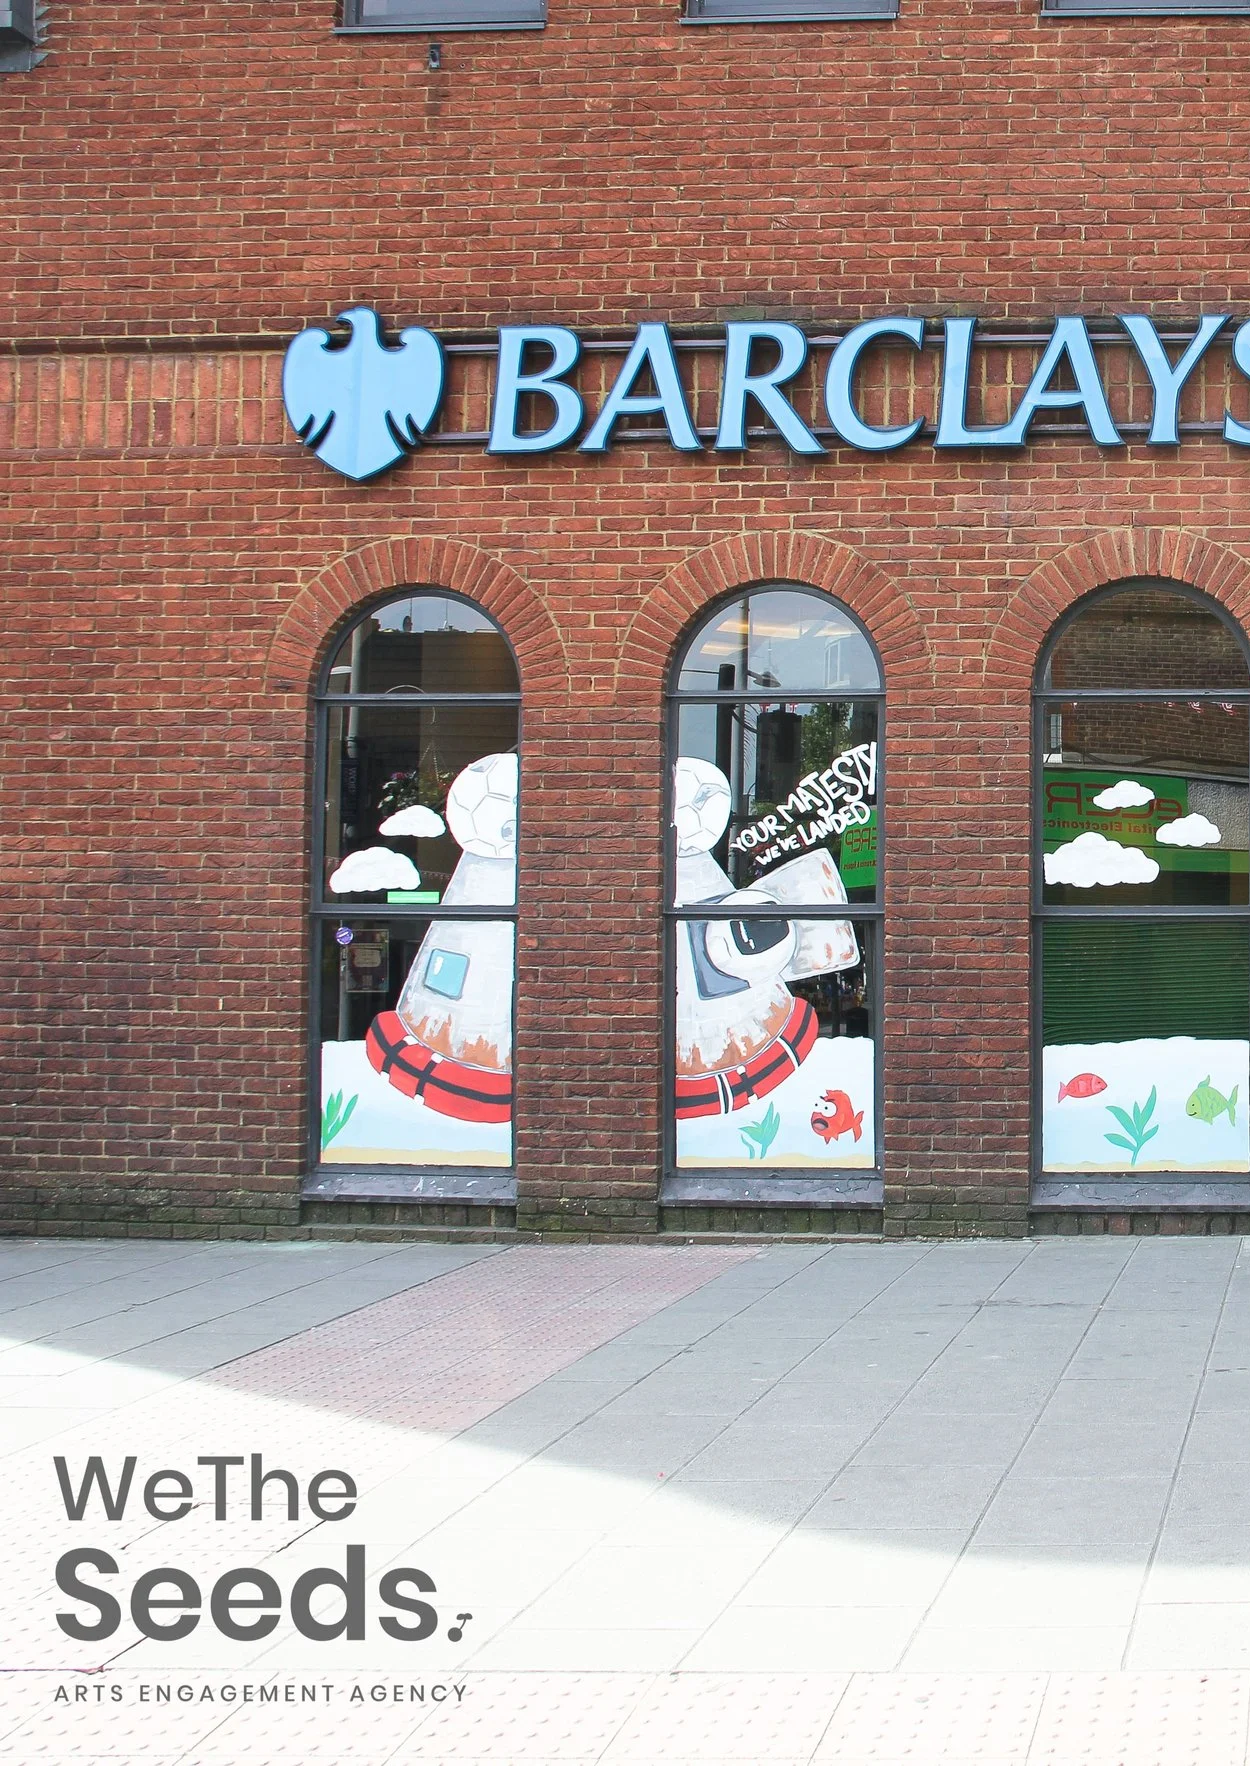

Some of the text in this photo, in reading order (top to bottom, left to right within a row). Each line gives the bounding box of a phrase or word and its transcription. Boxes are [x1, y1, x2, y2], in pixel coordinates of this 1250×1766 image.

[730, 741, 877, 852] YOUR MAJESTY
[755, 800, 871, 866] WE'VE LANDED
